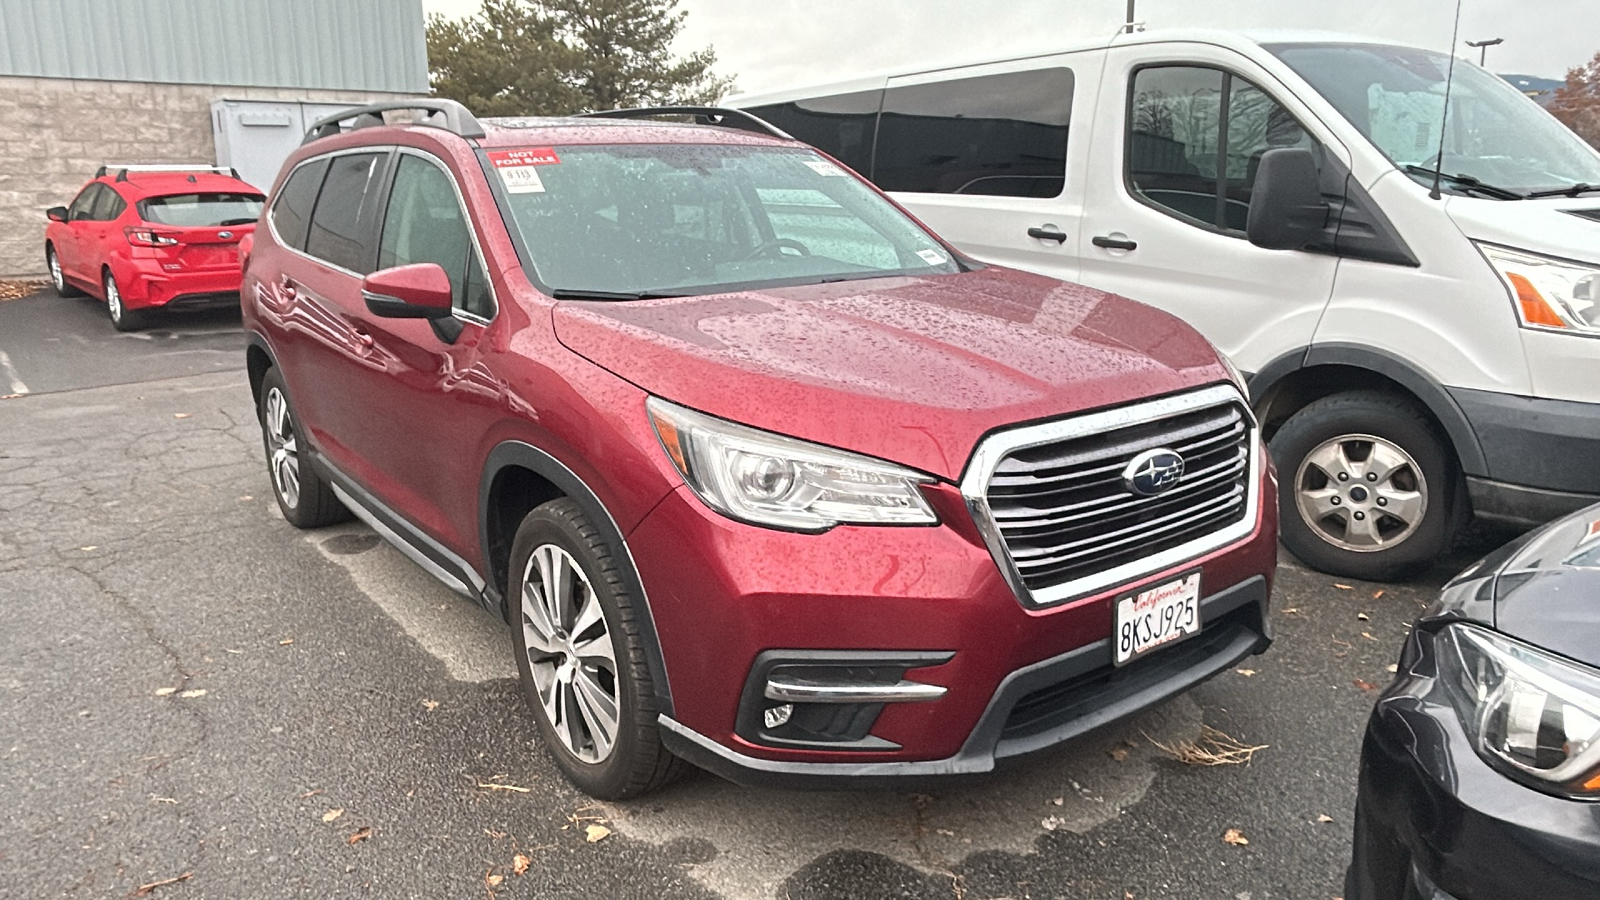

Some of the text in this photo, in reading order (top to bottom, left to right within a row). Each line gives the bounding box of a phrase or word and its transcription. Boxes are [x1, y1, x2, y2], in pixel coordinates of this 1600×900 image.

[524, 156, 555, 164] SALE
[1134, 586, 1184, 612] California
[1121, 597, 1194, 652] 8KSJ925
